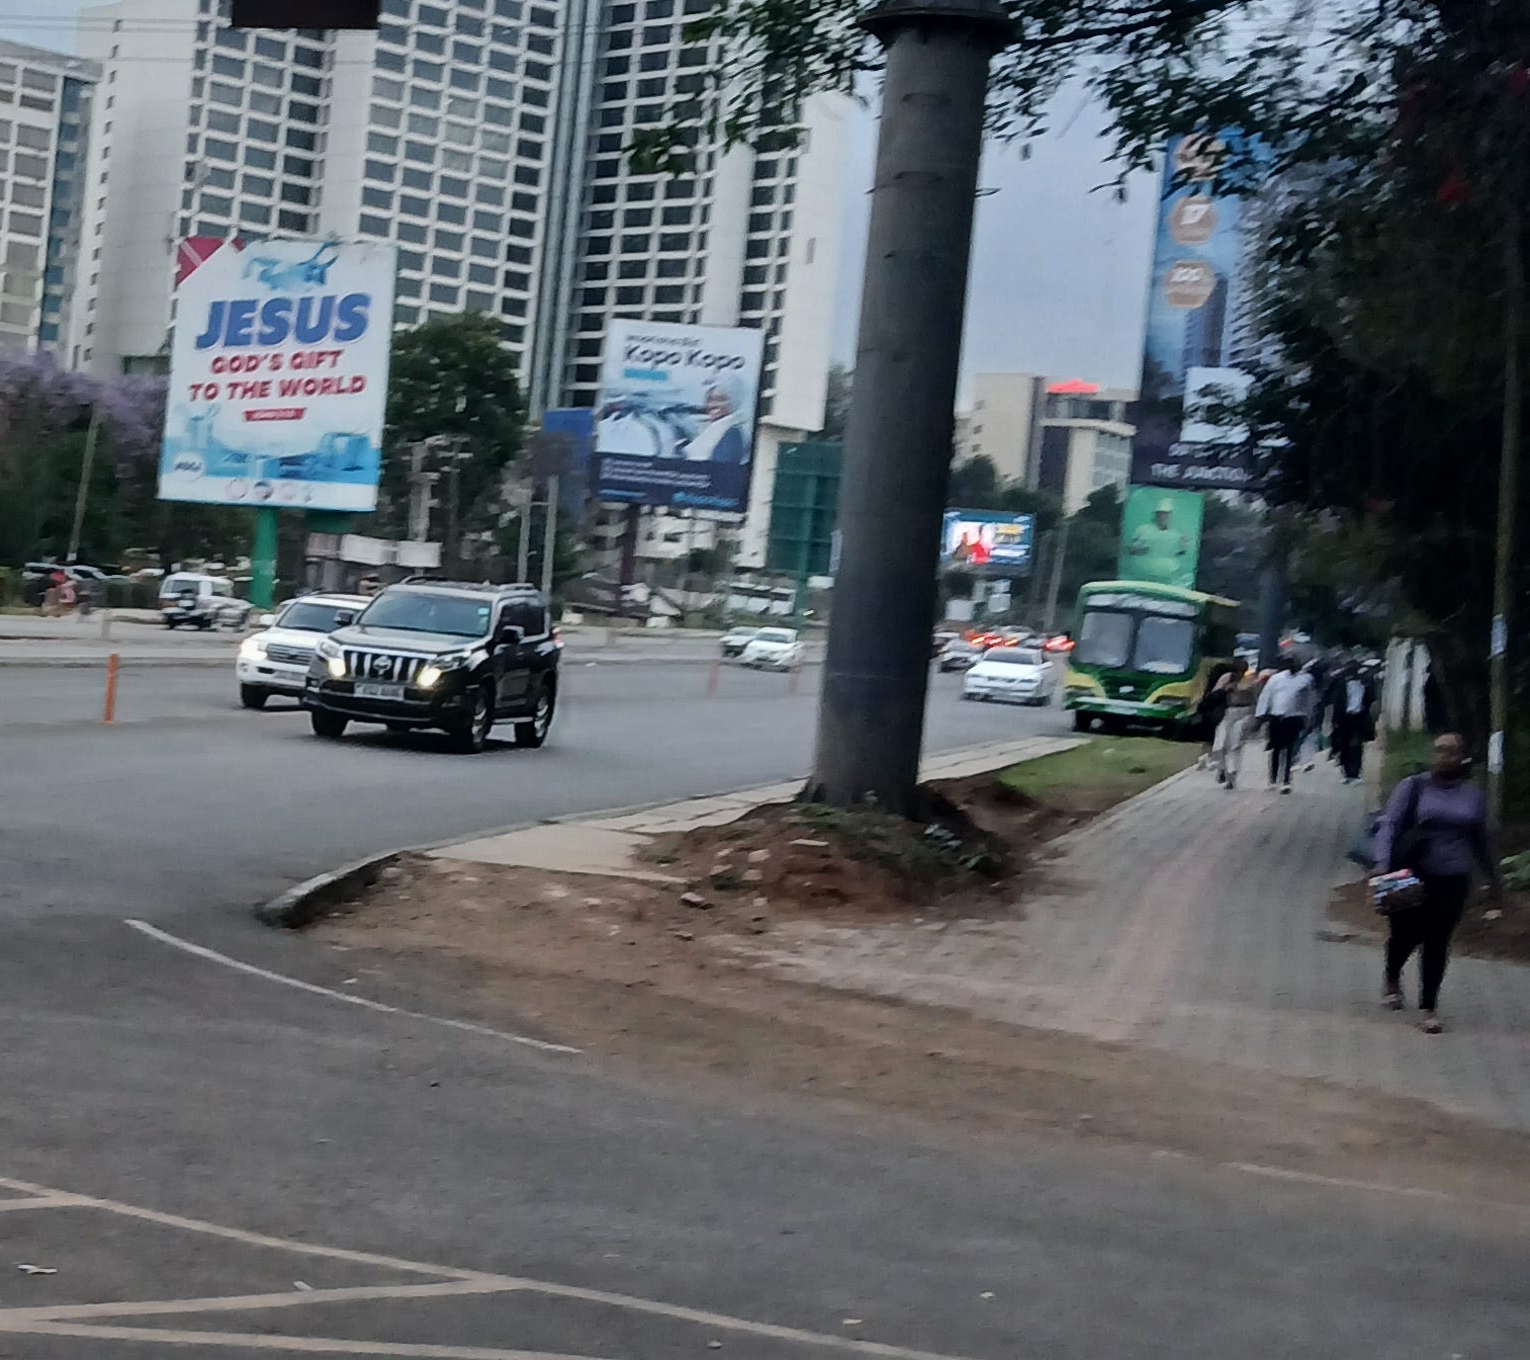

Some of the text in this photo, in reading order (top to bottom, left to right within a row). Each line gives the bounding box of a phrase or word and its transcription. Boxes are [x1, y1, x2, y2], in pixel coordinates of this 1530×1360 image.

[196, 293, 373, 350] JESUS
[211, 350, 345, 375] GOD'S GIFT
[624, 345, 746, 375] Kopo Kopo
[189, 375, 367, 401] TO THE WORLD
